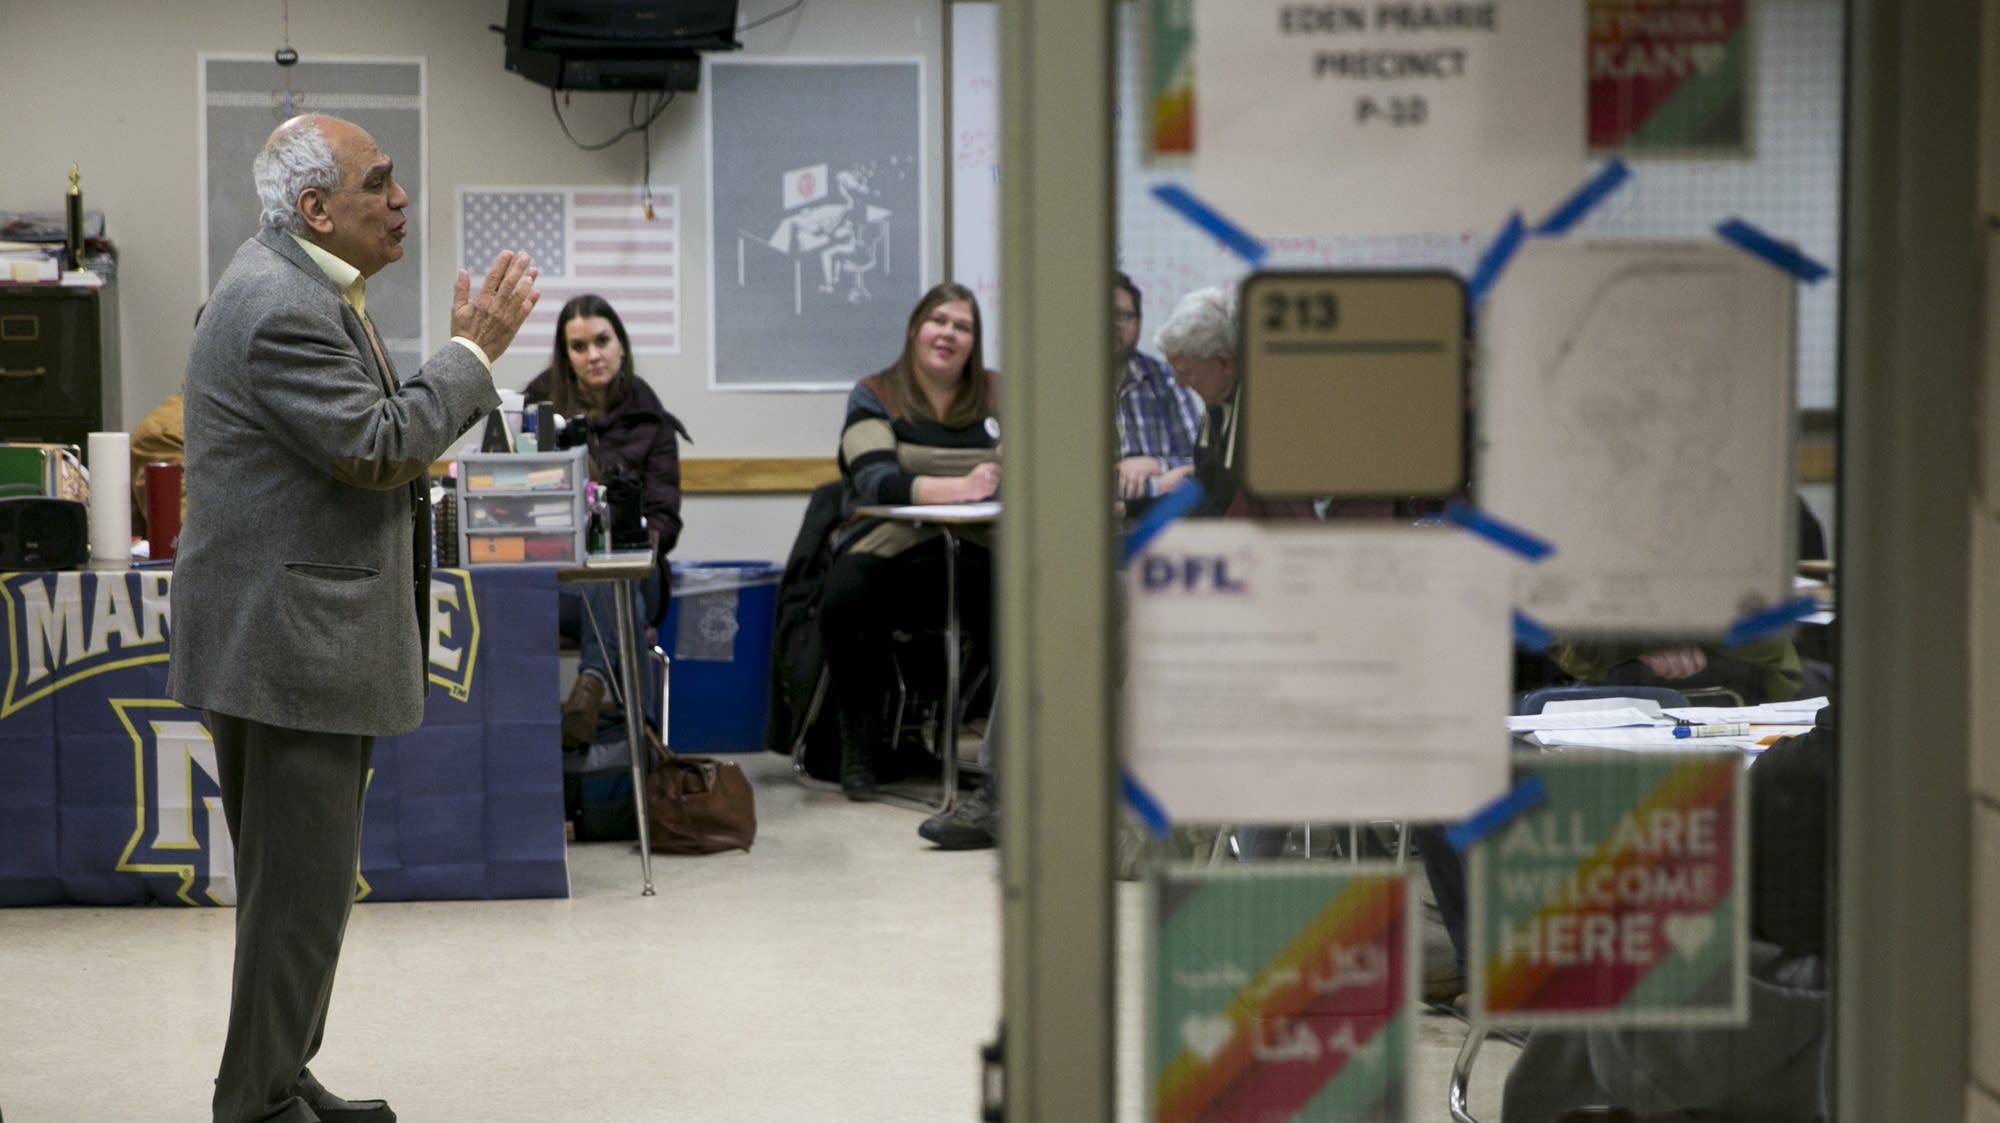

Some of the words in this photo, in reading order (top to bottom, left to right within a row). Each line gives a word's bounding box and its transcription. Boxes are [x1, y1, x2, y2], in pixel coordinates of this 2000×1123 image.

[1279, 5, 1366, 32] EDEN
[1375, 3, 1495, 30] PRAIRIE
[1313, 51, 1464, 78] PRECINCT
[1263, 290, 1338, 330] 213
[1141, 555, 1247, 593] DFL
[1503, 812, 1590, 855] ALL
[1611, 811, 1718, 855] ARE
[1502, 867, 1717, 902] WELCOME
[1500, 915, 1654, 965] HERE
